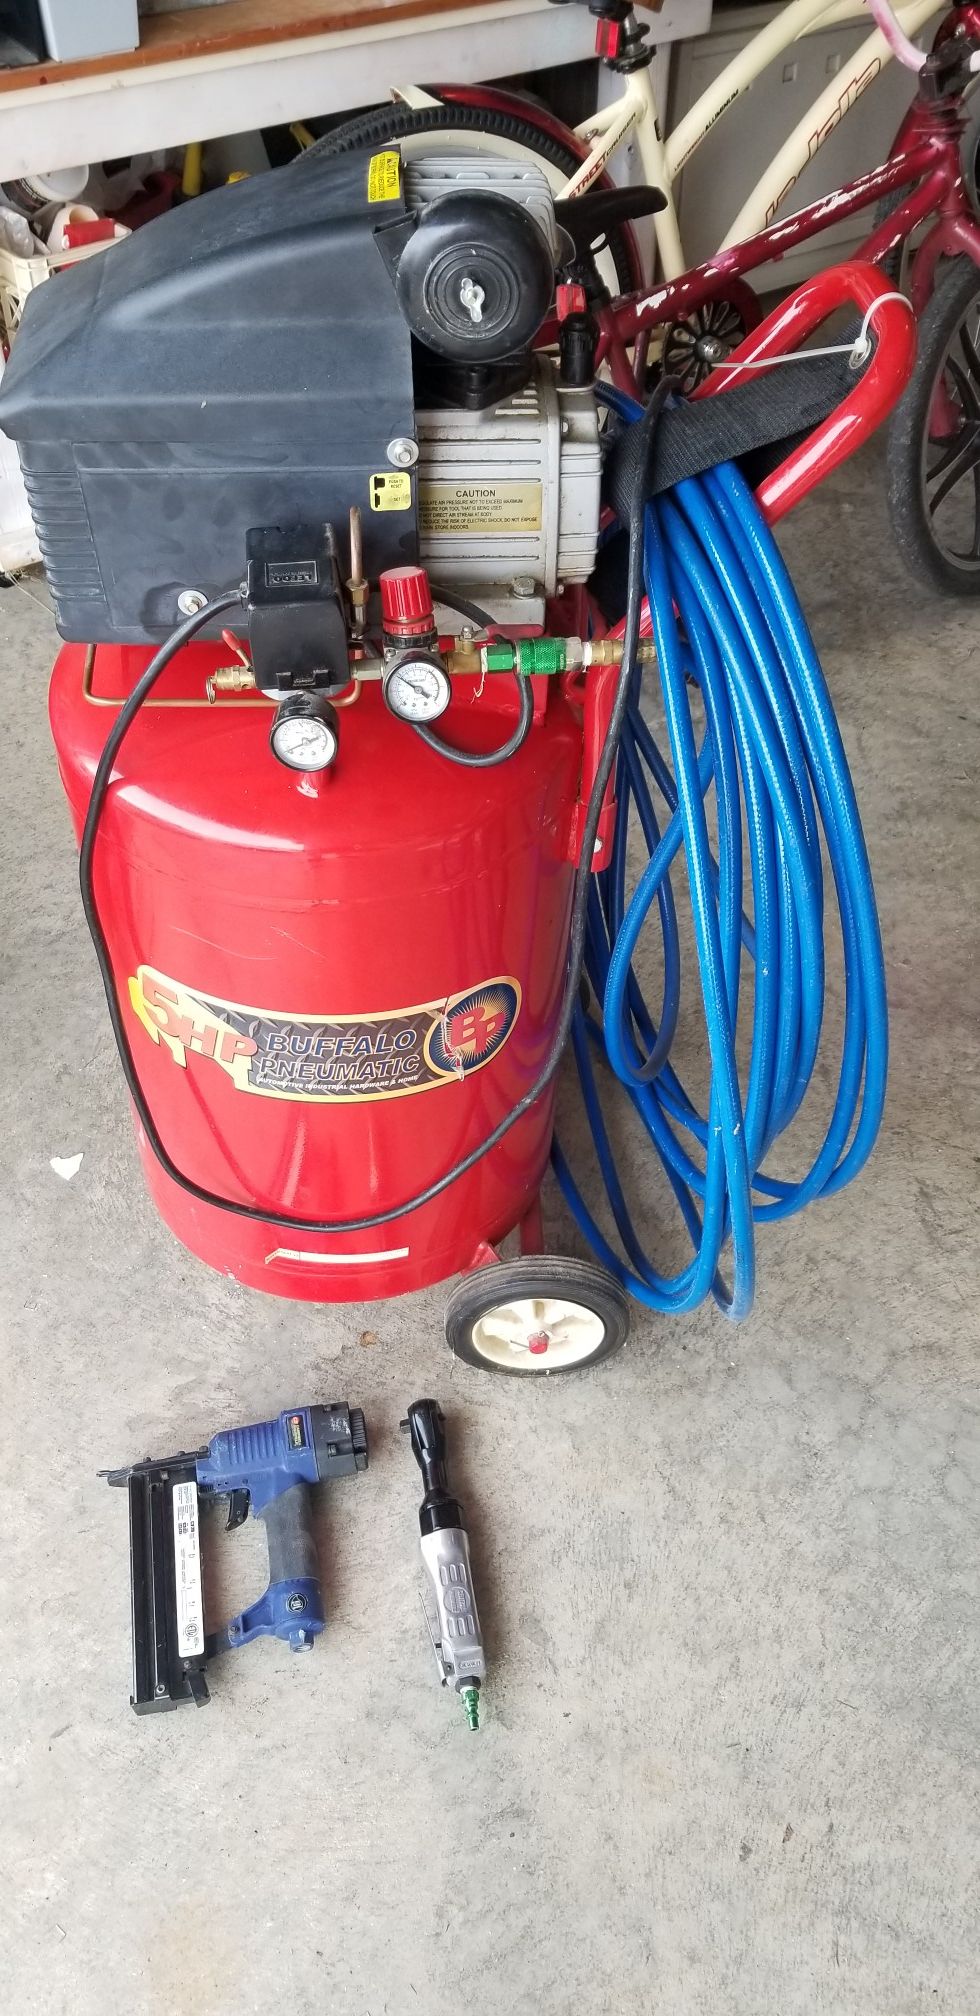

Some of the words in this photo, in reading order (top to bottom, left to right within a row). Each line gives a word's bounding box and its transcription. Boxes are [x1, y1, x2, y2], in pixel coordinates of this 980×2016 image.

[705, 89, 739, 131] ALUMINUM
[569, 151, 607, 199] STREET
[456, 489, 496, 498] CAUTION
[143, 972, 258, 1063] 5HP
[267, 1029, 417, 1057] BUFFALO
[260, 1055, 421, 1081] PNEUMATIC
[258, 1077, 303, 1089] AUTOMOTIVE
[349, 1081, 390, 1090] HARDWARE
[398, 1075, 420, 1083] HOME
